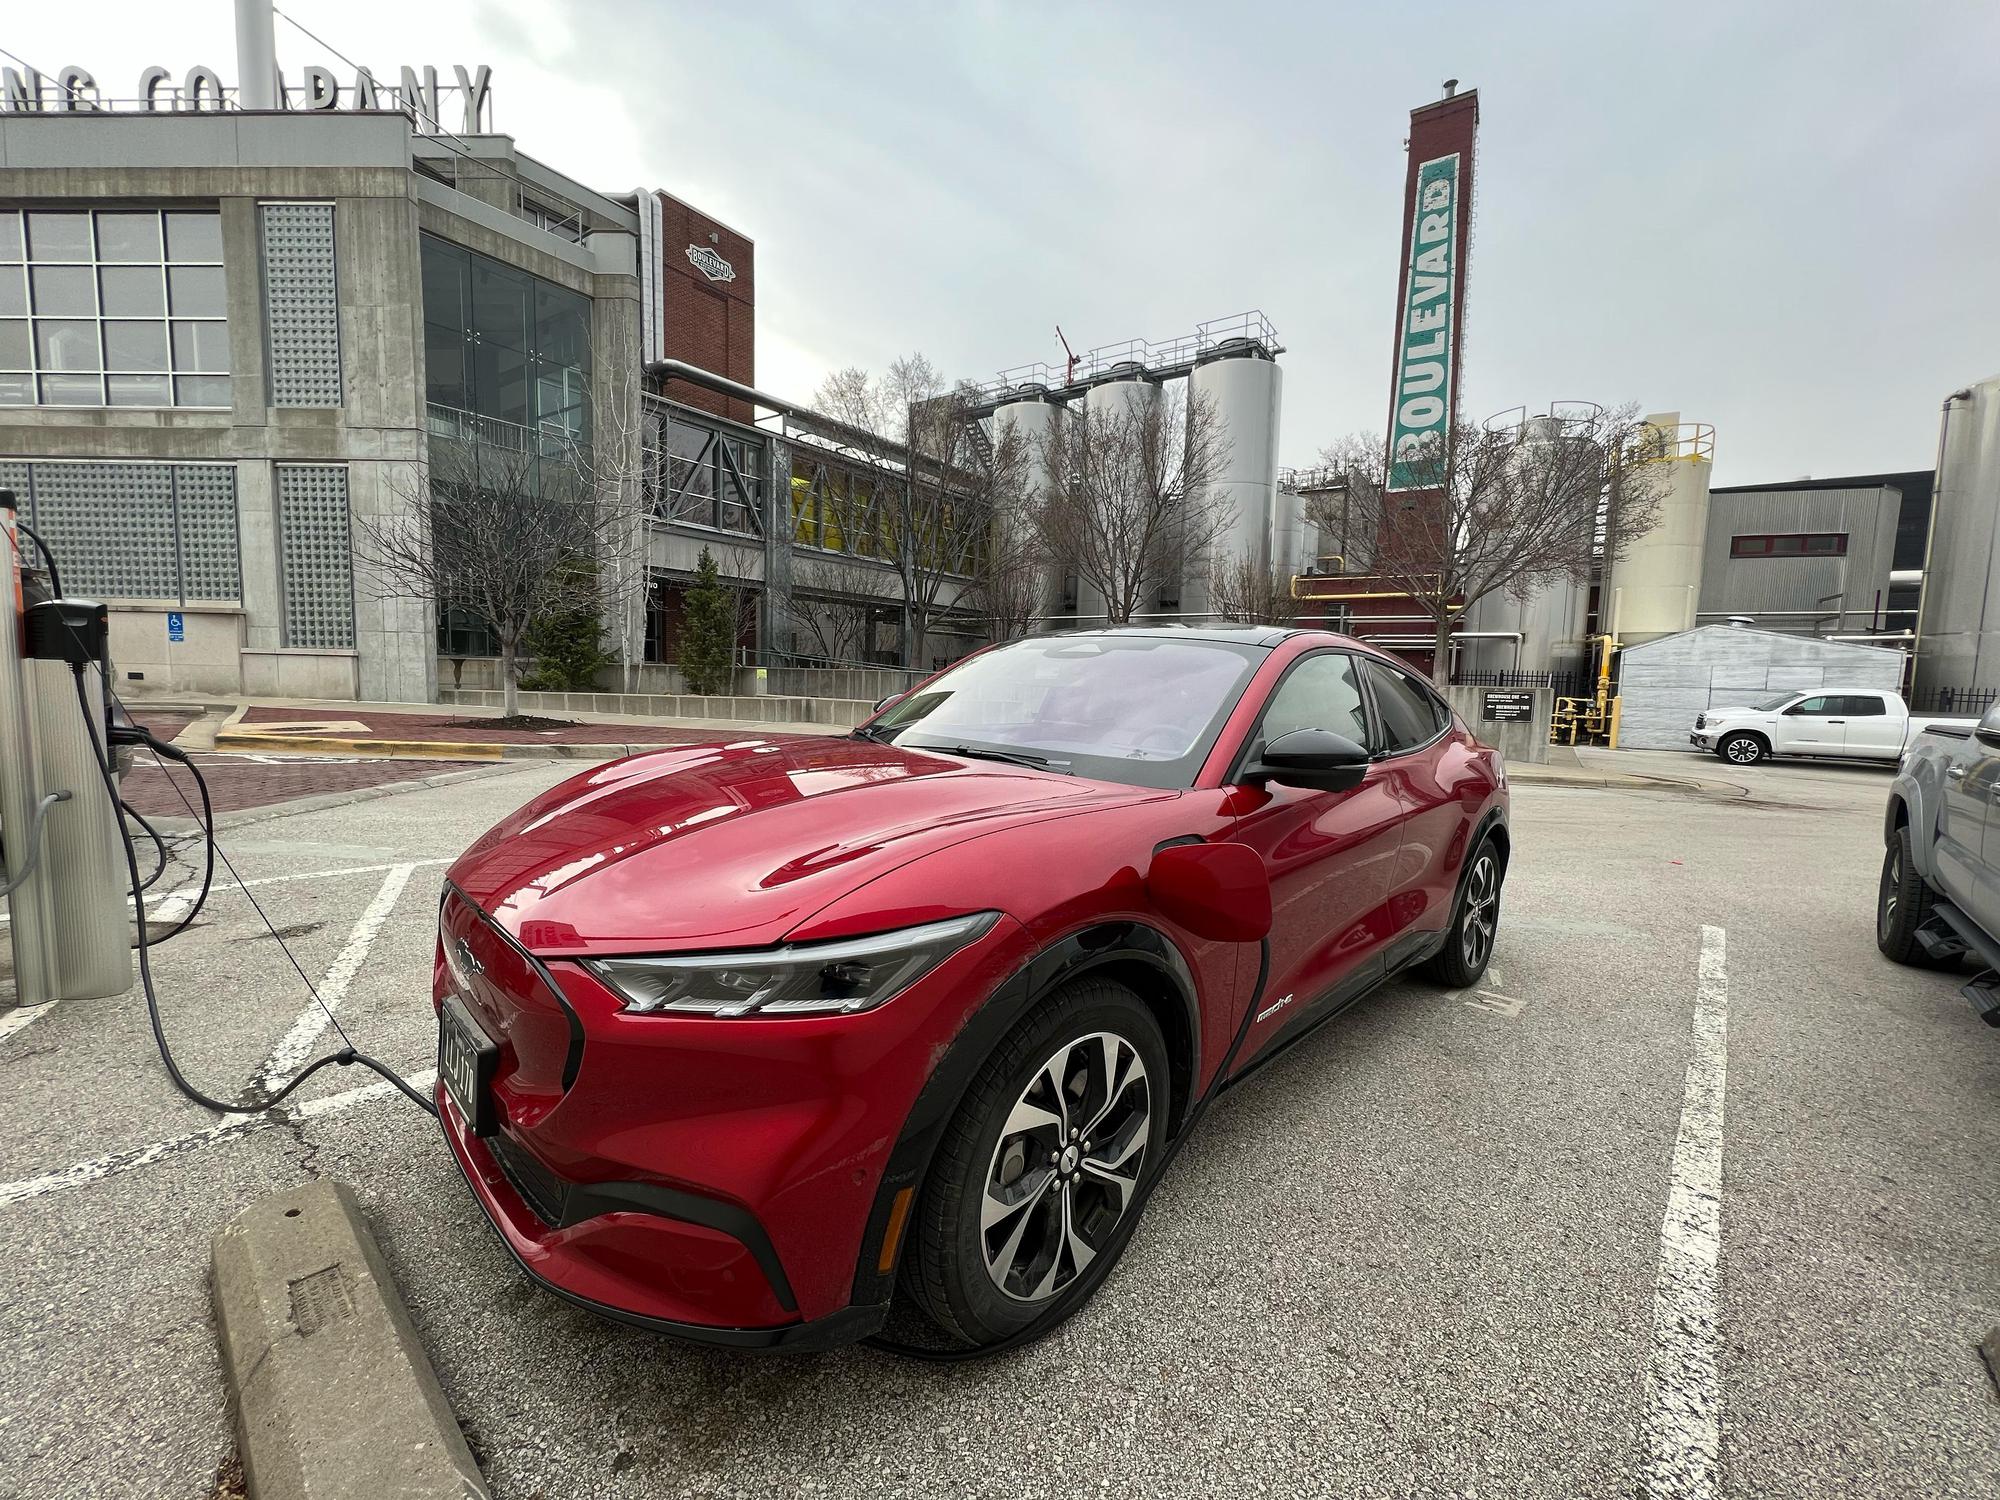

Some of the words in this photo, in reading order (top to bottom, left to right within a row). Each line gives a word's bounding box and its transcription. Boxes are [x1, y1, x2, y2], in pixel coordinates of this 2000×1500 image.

[138, 65, 491, 134] COPANY
[692, 249, 729, 277] BOULEVARD
[1396, 179, 1450, 463] BOULEVARD
